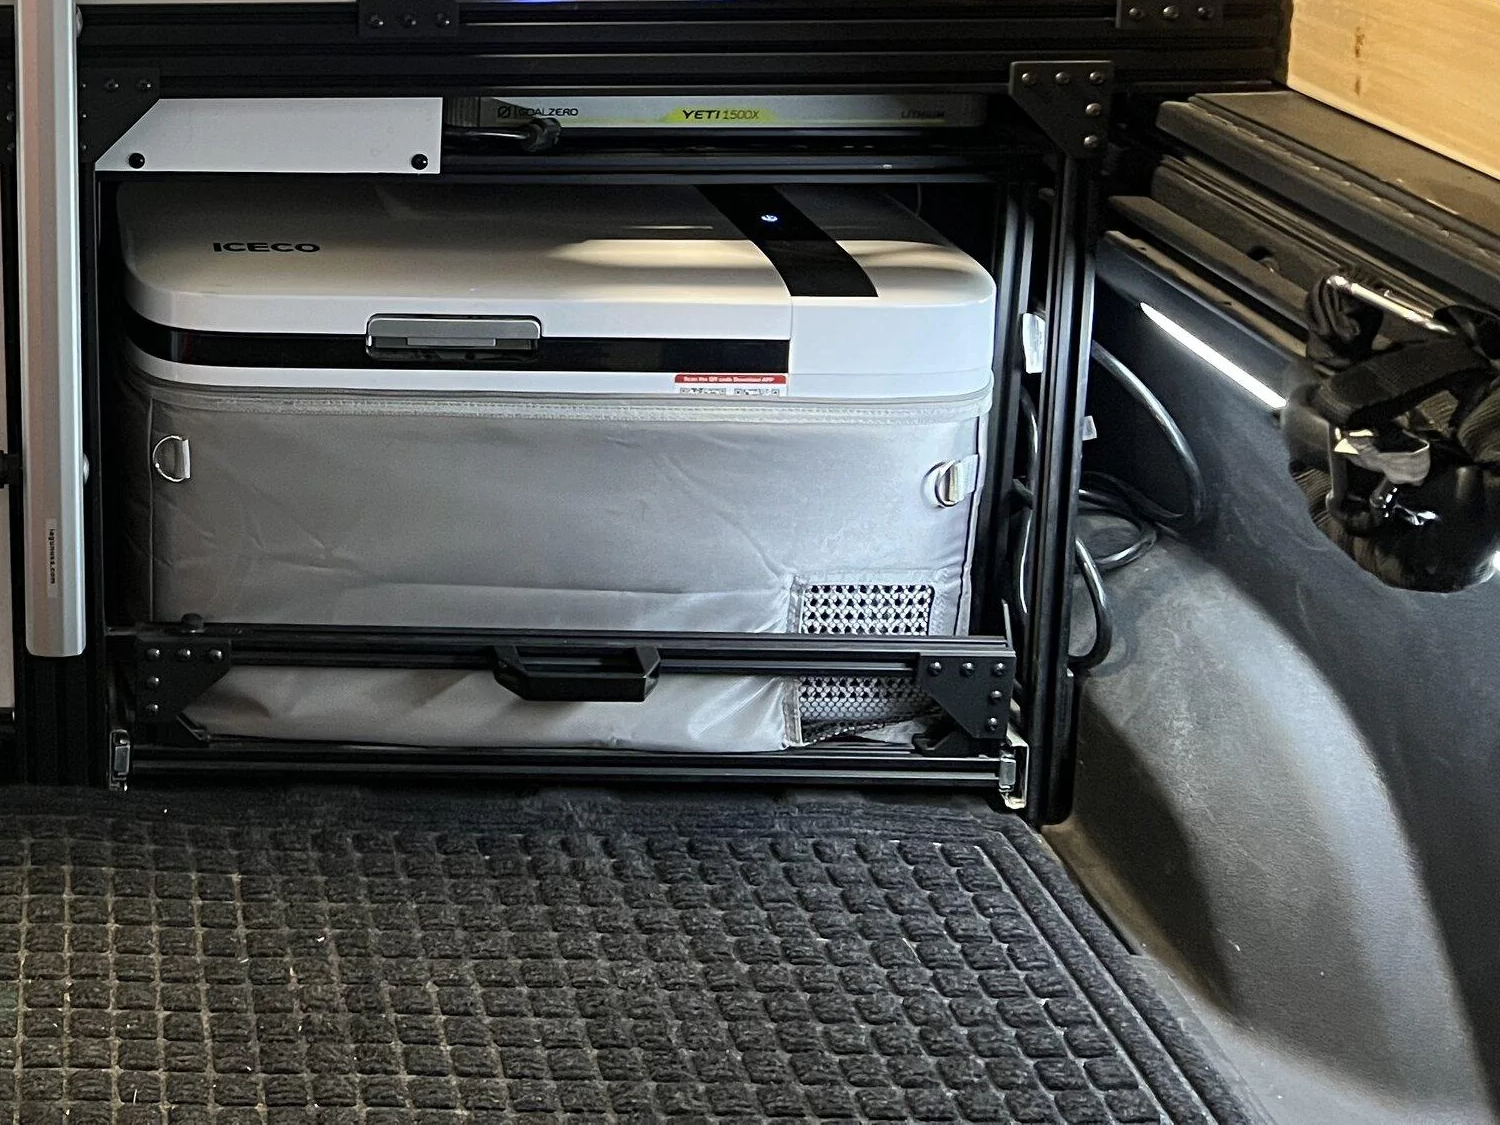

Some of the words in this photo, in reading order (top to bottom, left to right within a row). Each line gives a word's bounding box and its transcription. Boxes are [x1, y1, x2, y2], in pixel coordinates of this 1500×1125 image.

[682, 109, 721, 120] YETI
[722, 110, 760, 120] 1500X
[212, 242, 321, 253] ICECO
